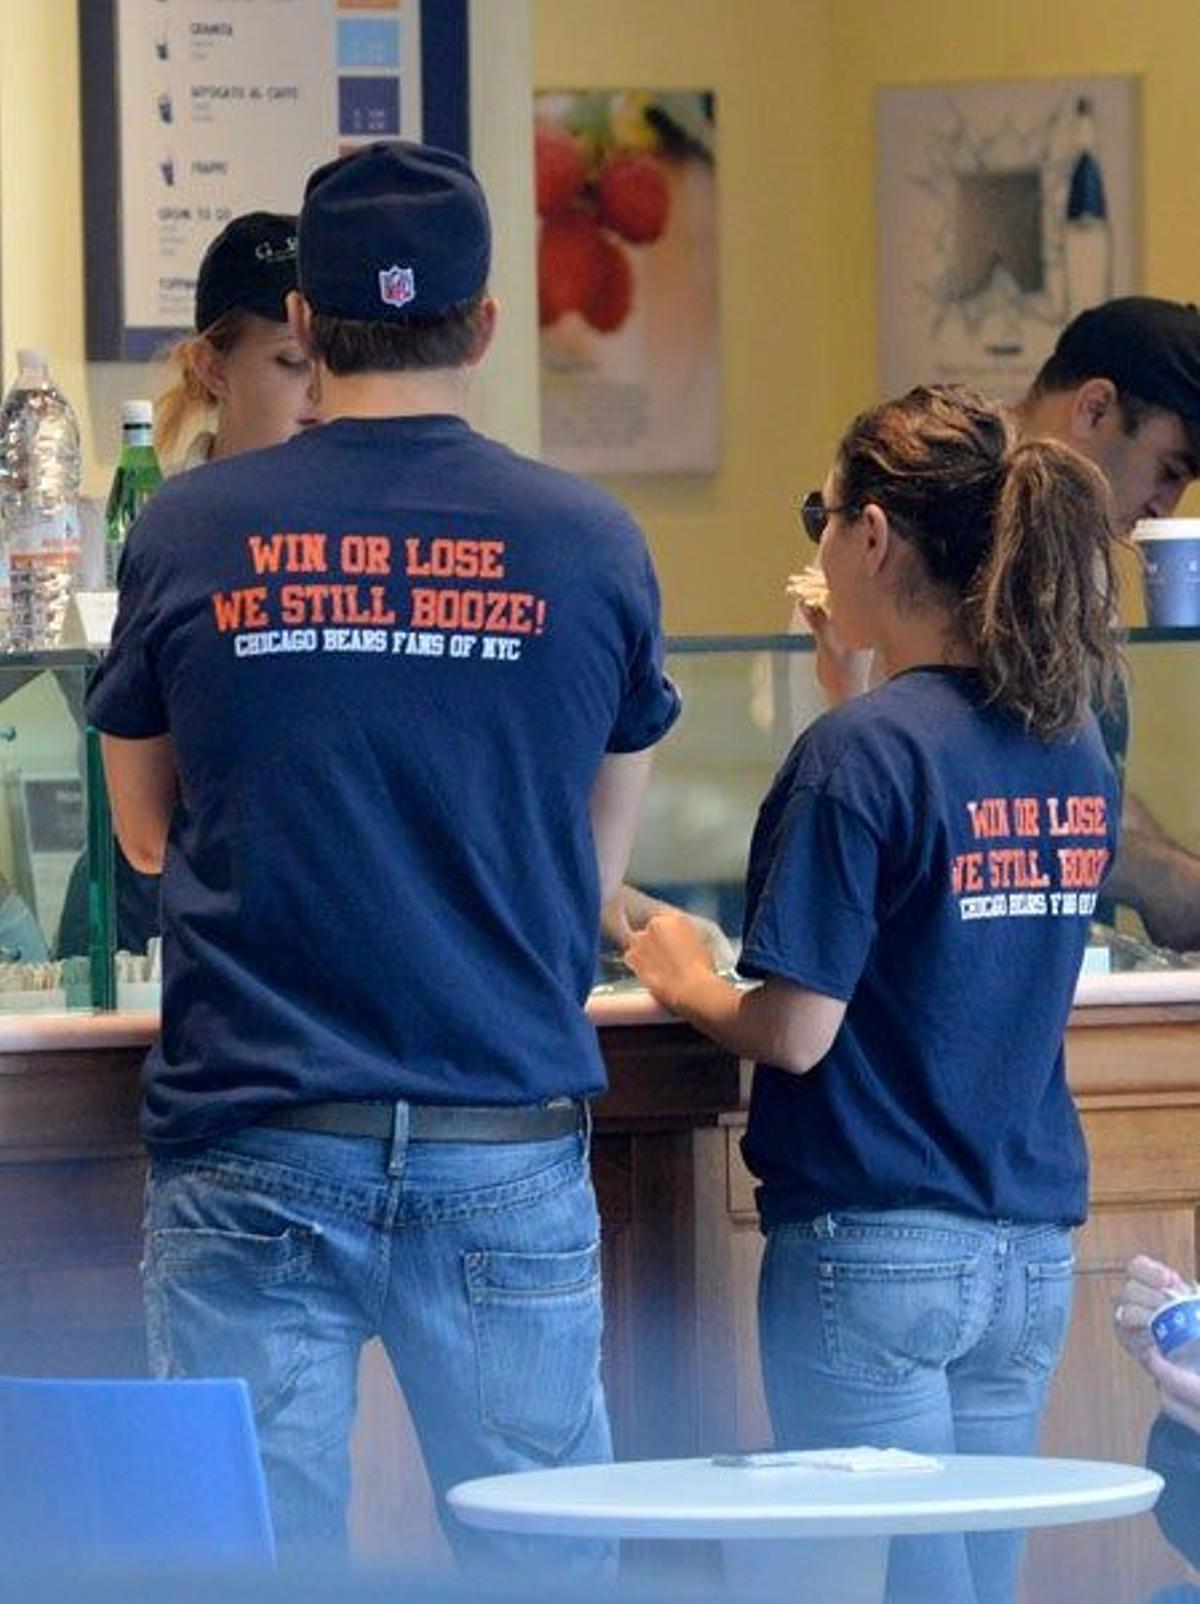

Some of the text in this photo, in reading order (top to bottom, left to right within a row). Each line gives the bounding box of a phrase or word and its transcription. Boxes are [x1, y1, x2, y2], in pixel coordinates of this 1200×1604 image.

[249, 533, 505, 578] WIN OR LOSE
[212, 584, 546, 634] WE STILL BOOZE!
[234, 629, 521, 661] CHICAGO BEARS FANS OF NYC
[966, 795, 1107, 839] WIN OR LOSE
[988, 848, 1050, 888] STILL
